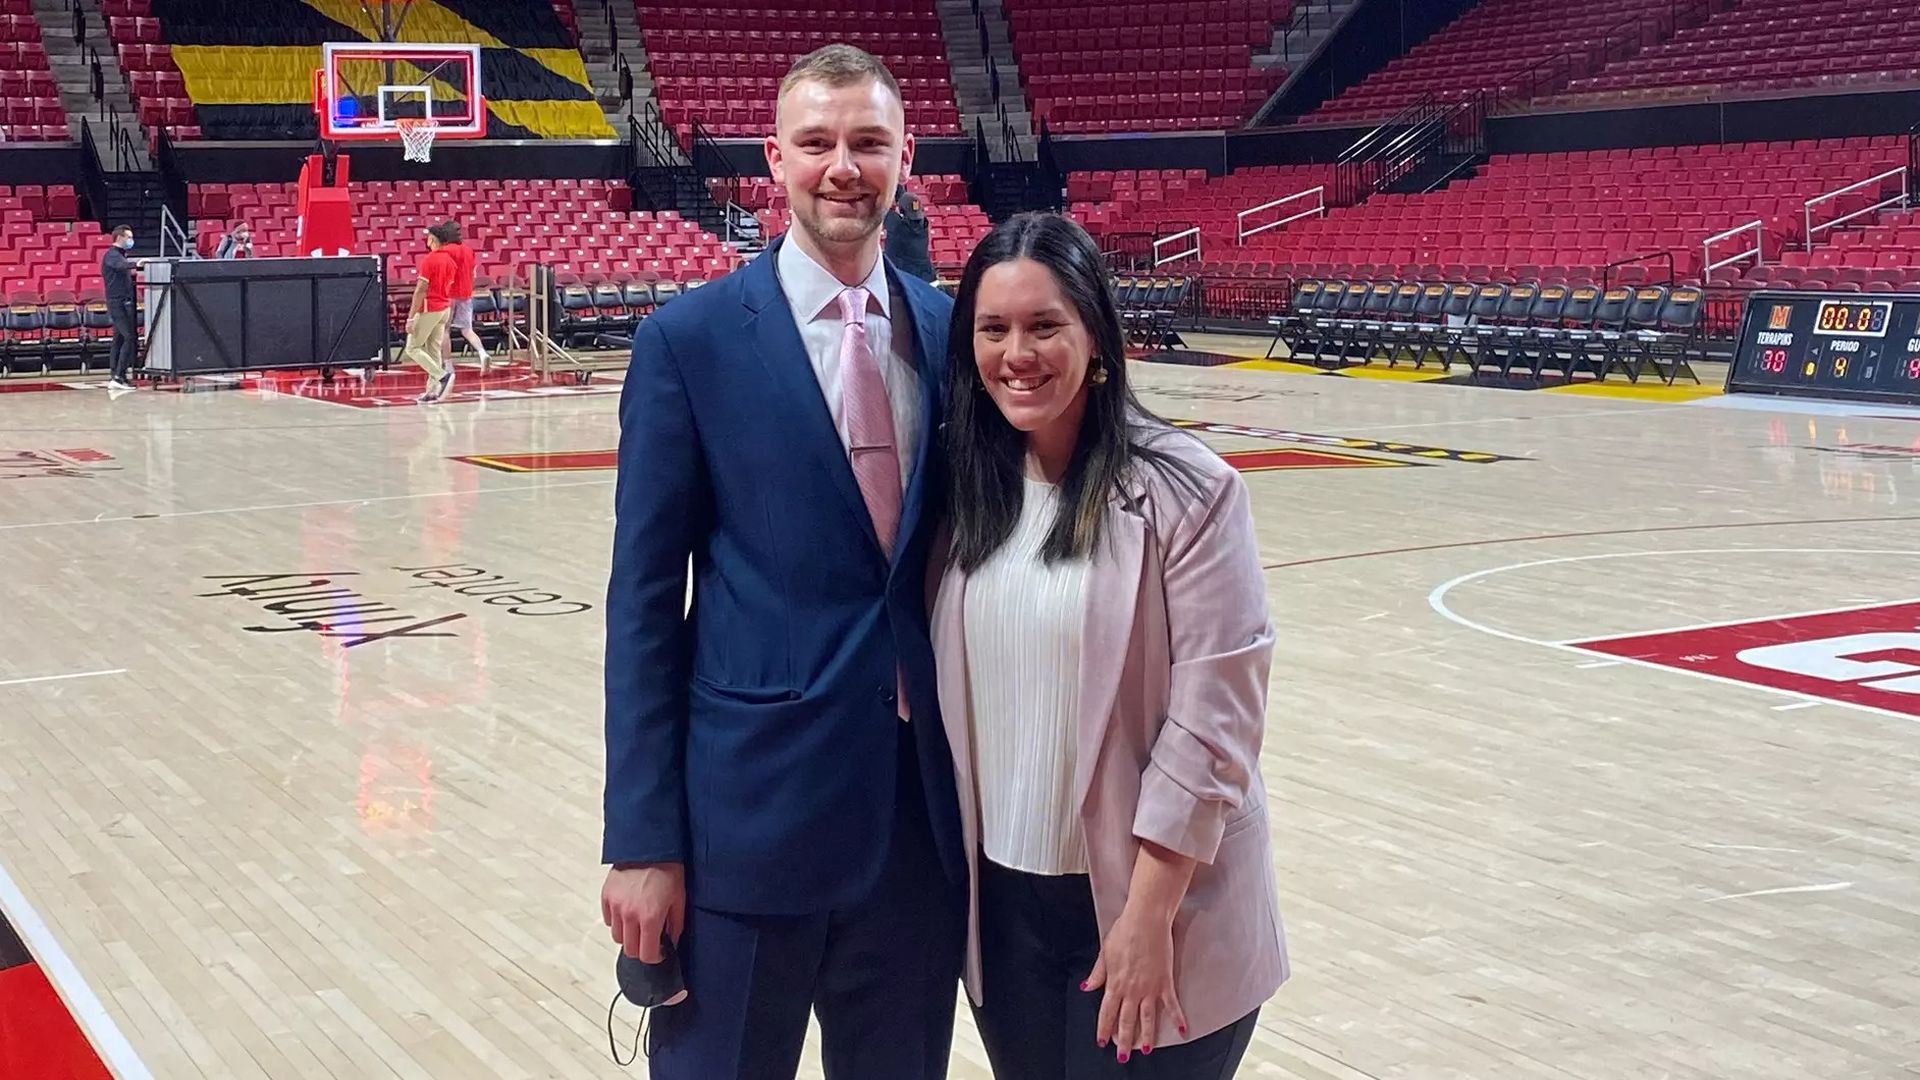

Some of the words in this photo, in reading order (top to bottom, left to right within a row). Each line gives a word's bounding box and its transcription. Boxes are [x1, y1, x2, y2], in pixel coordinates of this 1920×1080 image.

[1757, 332, 1794, 346] TERRAPINS
[1830, 340, 1860, 352] PERIOD
[391, 563, 593, 617] center
